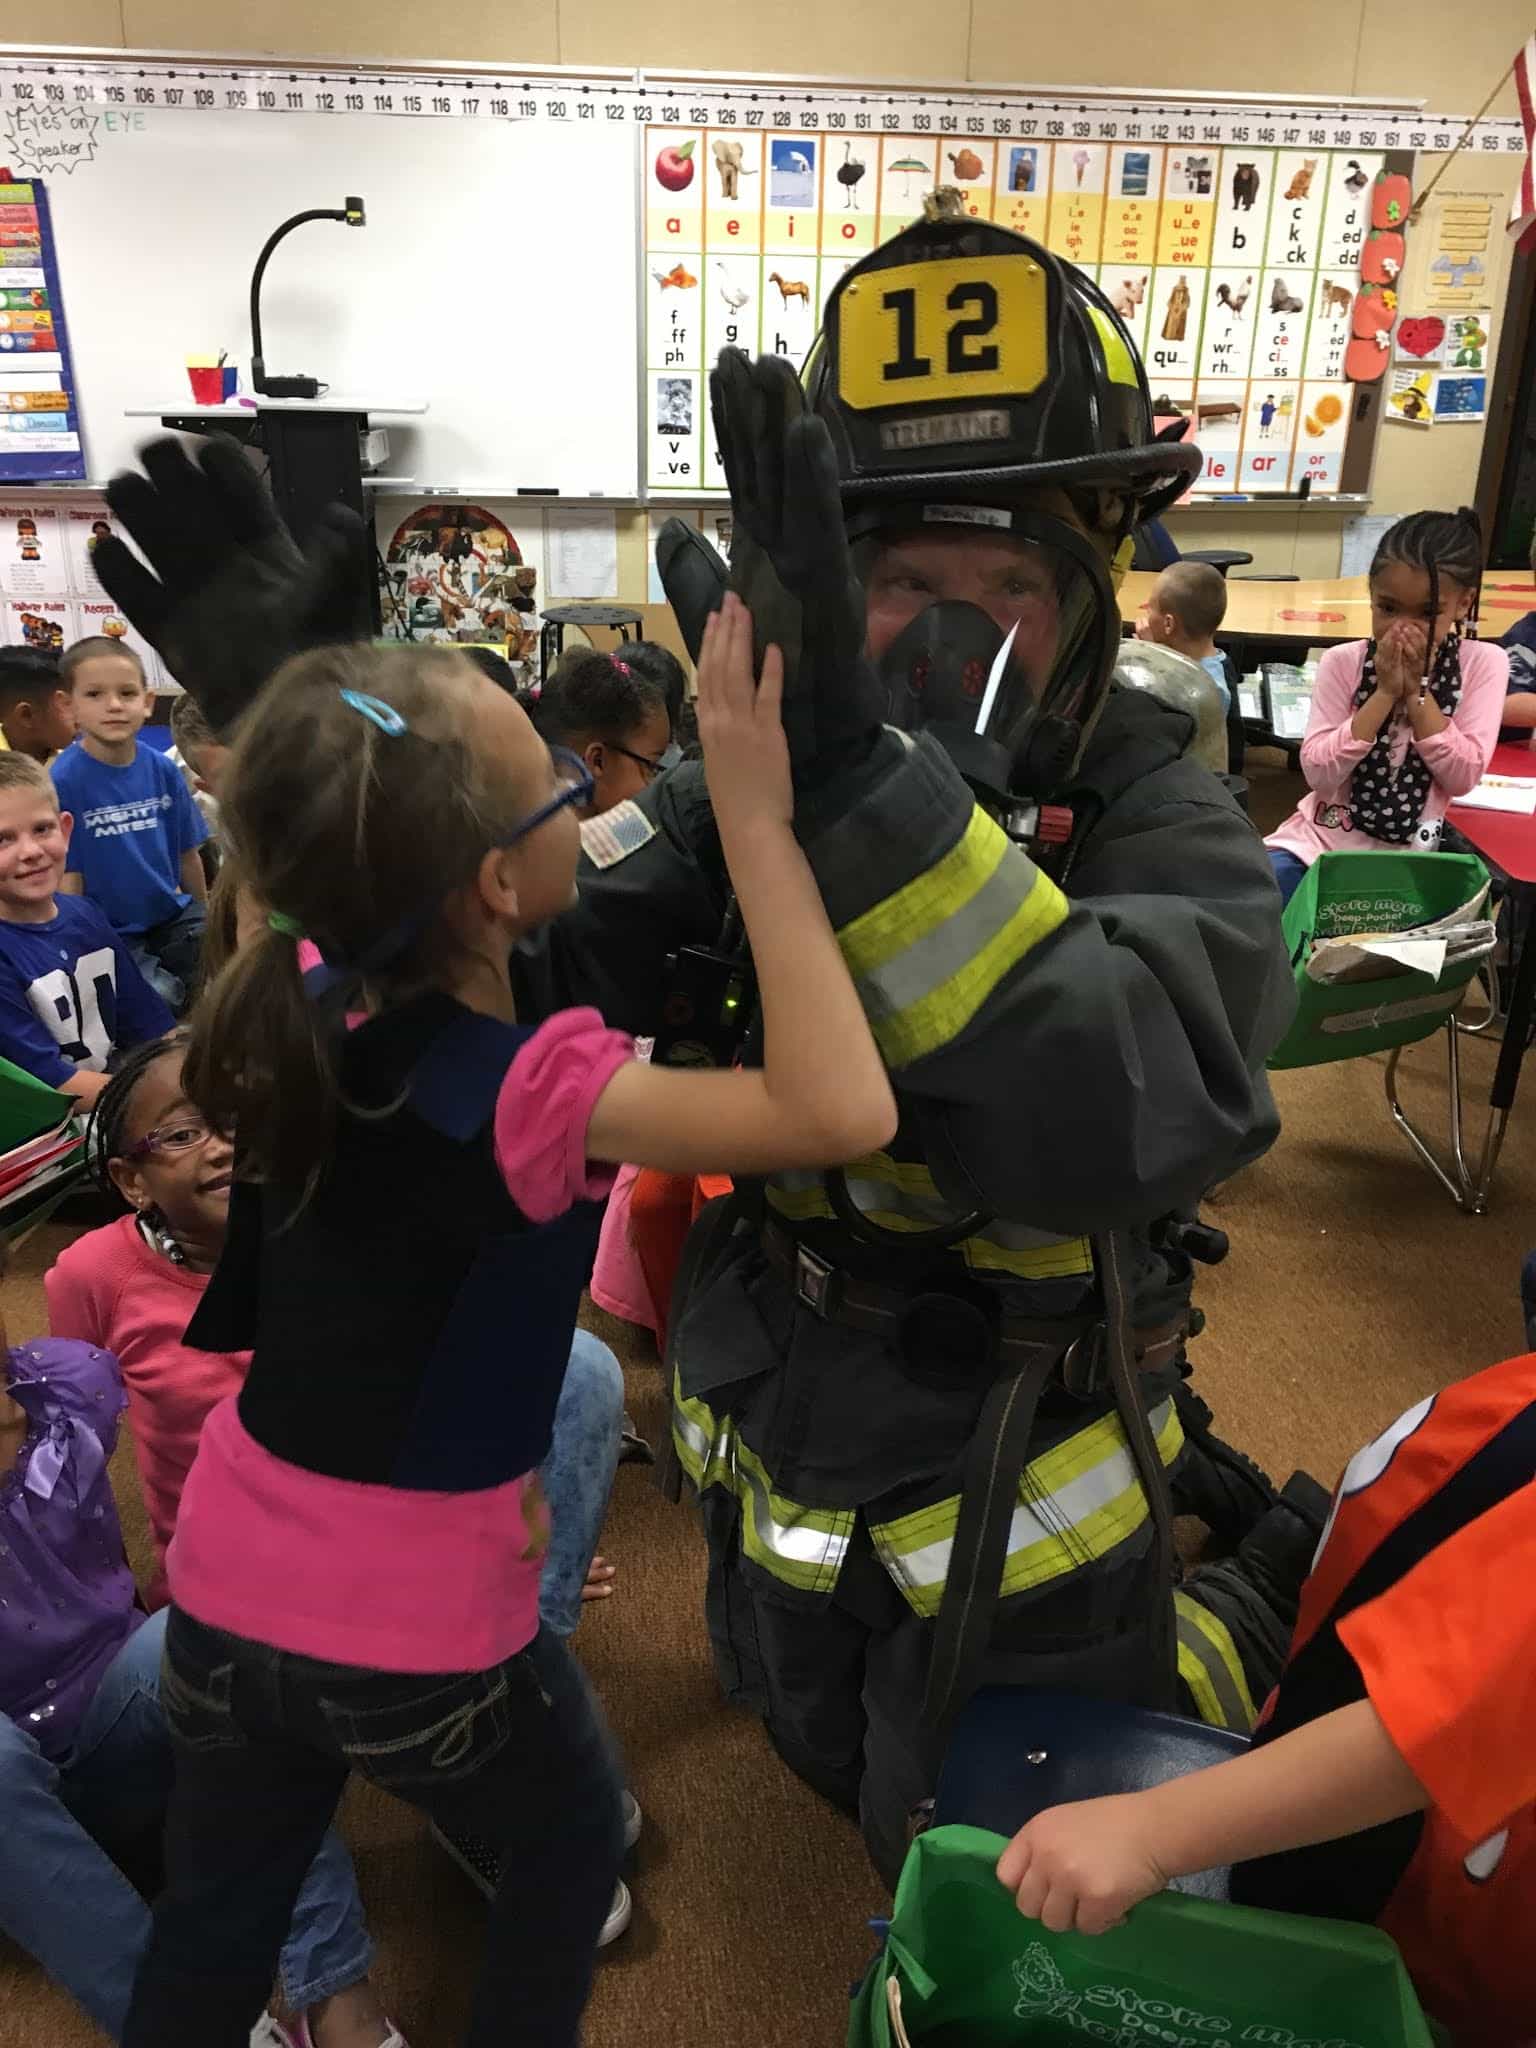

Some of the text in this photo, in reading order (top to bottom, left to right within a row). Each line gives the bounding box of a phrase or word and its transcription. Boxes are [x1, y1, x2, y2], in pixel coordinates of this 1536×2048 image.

[12, 83, 34, 99] 102
[43, 84, 64, 100] 103
[73, 85, 94, 101] 104
[104, 86, 125, 102] 105
[134, 87, 155, 103] 106
[163, 88, 184, 104] 107
[193, 89, 214, 105] 108
[225, 90, 246, 106] 109
[256, 91, 275, 107] 110
[286, 92, 303, 108] 111
[315, 93, 334, 109] 112
[345, 94, 363, 110] 113
[374, 95, 392, 111] 114
[403, 96, 422, 112] 115
[432, 97, 450, 113] 116
[462, 98, 479, 114] 117
[490, 99, 508, 115] 118
[518, 100, 536, 116] 119
[547, 101, 566, 117] 120
[577, 103, 594, 118] 121
[605, 104, 624, 120] 122
[633, 105, 652, 121] 123
[662, 106, 680, 122] 124
[689, 108, 708, 123] 125
[717, 109, 736, 124] 126
[745, 110, 764, 125] 127
[773, 111, 791, 126] 128
[800, 112, 818, 127] 129
[827, 113, 846, 128] 130
[854, 113, 871, 128] 131
[881, 114, 900, 129] 132
[912, 115, 931, 130] 133
[939, 116, 958, 131] 134
[966, 117, 984, 132] 135
[993, 118, 1011, 133] 136
[1020, 119, 1038, 134] 137
[1046, 121, 1064, 136] 138
[1072, 122, 1090, 137] 139
[1099, 123, 1117, 138] 140
[1125, 124, 1141, 138] 141
[1151, 124, 1169, 139] 142
[1177, 125, 1195, 140] 143
[1203, 126, 1220, 141] 144
[1231, 127, 1249, 142] 145
[1257, 128, 1275, 142] 146
[1283, 129, 1300, 143] 147
[1308, 130, 1326, 144] 148
[1334, 130, 1351, 145] 149
[1359, 131, 1377, 146] 150
[1384, 132, 1400, 146] 151
[1410, 132, 1426, 147] 152
[1434, 133, 1450, 148] 153
[1482, 135, 1499, 150] 155
[1507, 136, 1524, 151] 156
[17, 106, 89, 137] Eyes on
[105, 111, 146, 132] EYE
[24, 139, 81, 163] Speaker
[1184, 204, 1193, 214] u
[1292, 207, 1302, 220] c
[1345, 209, 1356, 225] d
[666, 218, 680, 233] a
[726, 220, 740, 235] e
[788, 216, 794, 237] i
[842, 223, 856, 239] o
[1289, 224, 1299, 241] k
[1232, 226, 1246, 249] b
[1172, 252, 1194, 262] ew
[671, 309, 678, 324] f
[726, 325, 738, 342] g
[882, 281, 998, 381] 12
[1225, 327, 1232, 337] r
[1279, 322, 1286, 332] s
[665, 347, 684, 365] ph
[888, 414, 1001, 448] TREMAINE
[669, 441, 680, 453] v
[1252, 455, 1276, 471] ar
[1309, 455, 1325, 465] or
[1304, 470, 1328, 481] ore
[95, 817, 158, 838] MITES
[25, 946, 117, 1073] 90
[1085, 1984, 1232, 2033] Store
